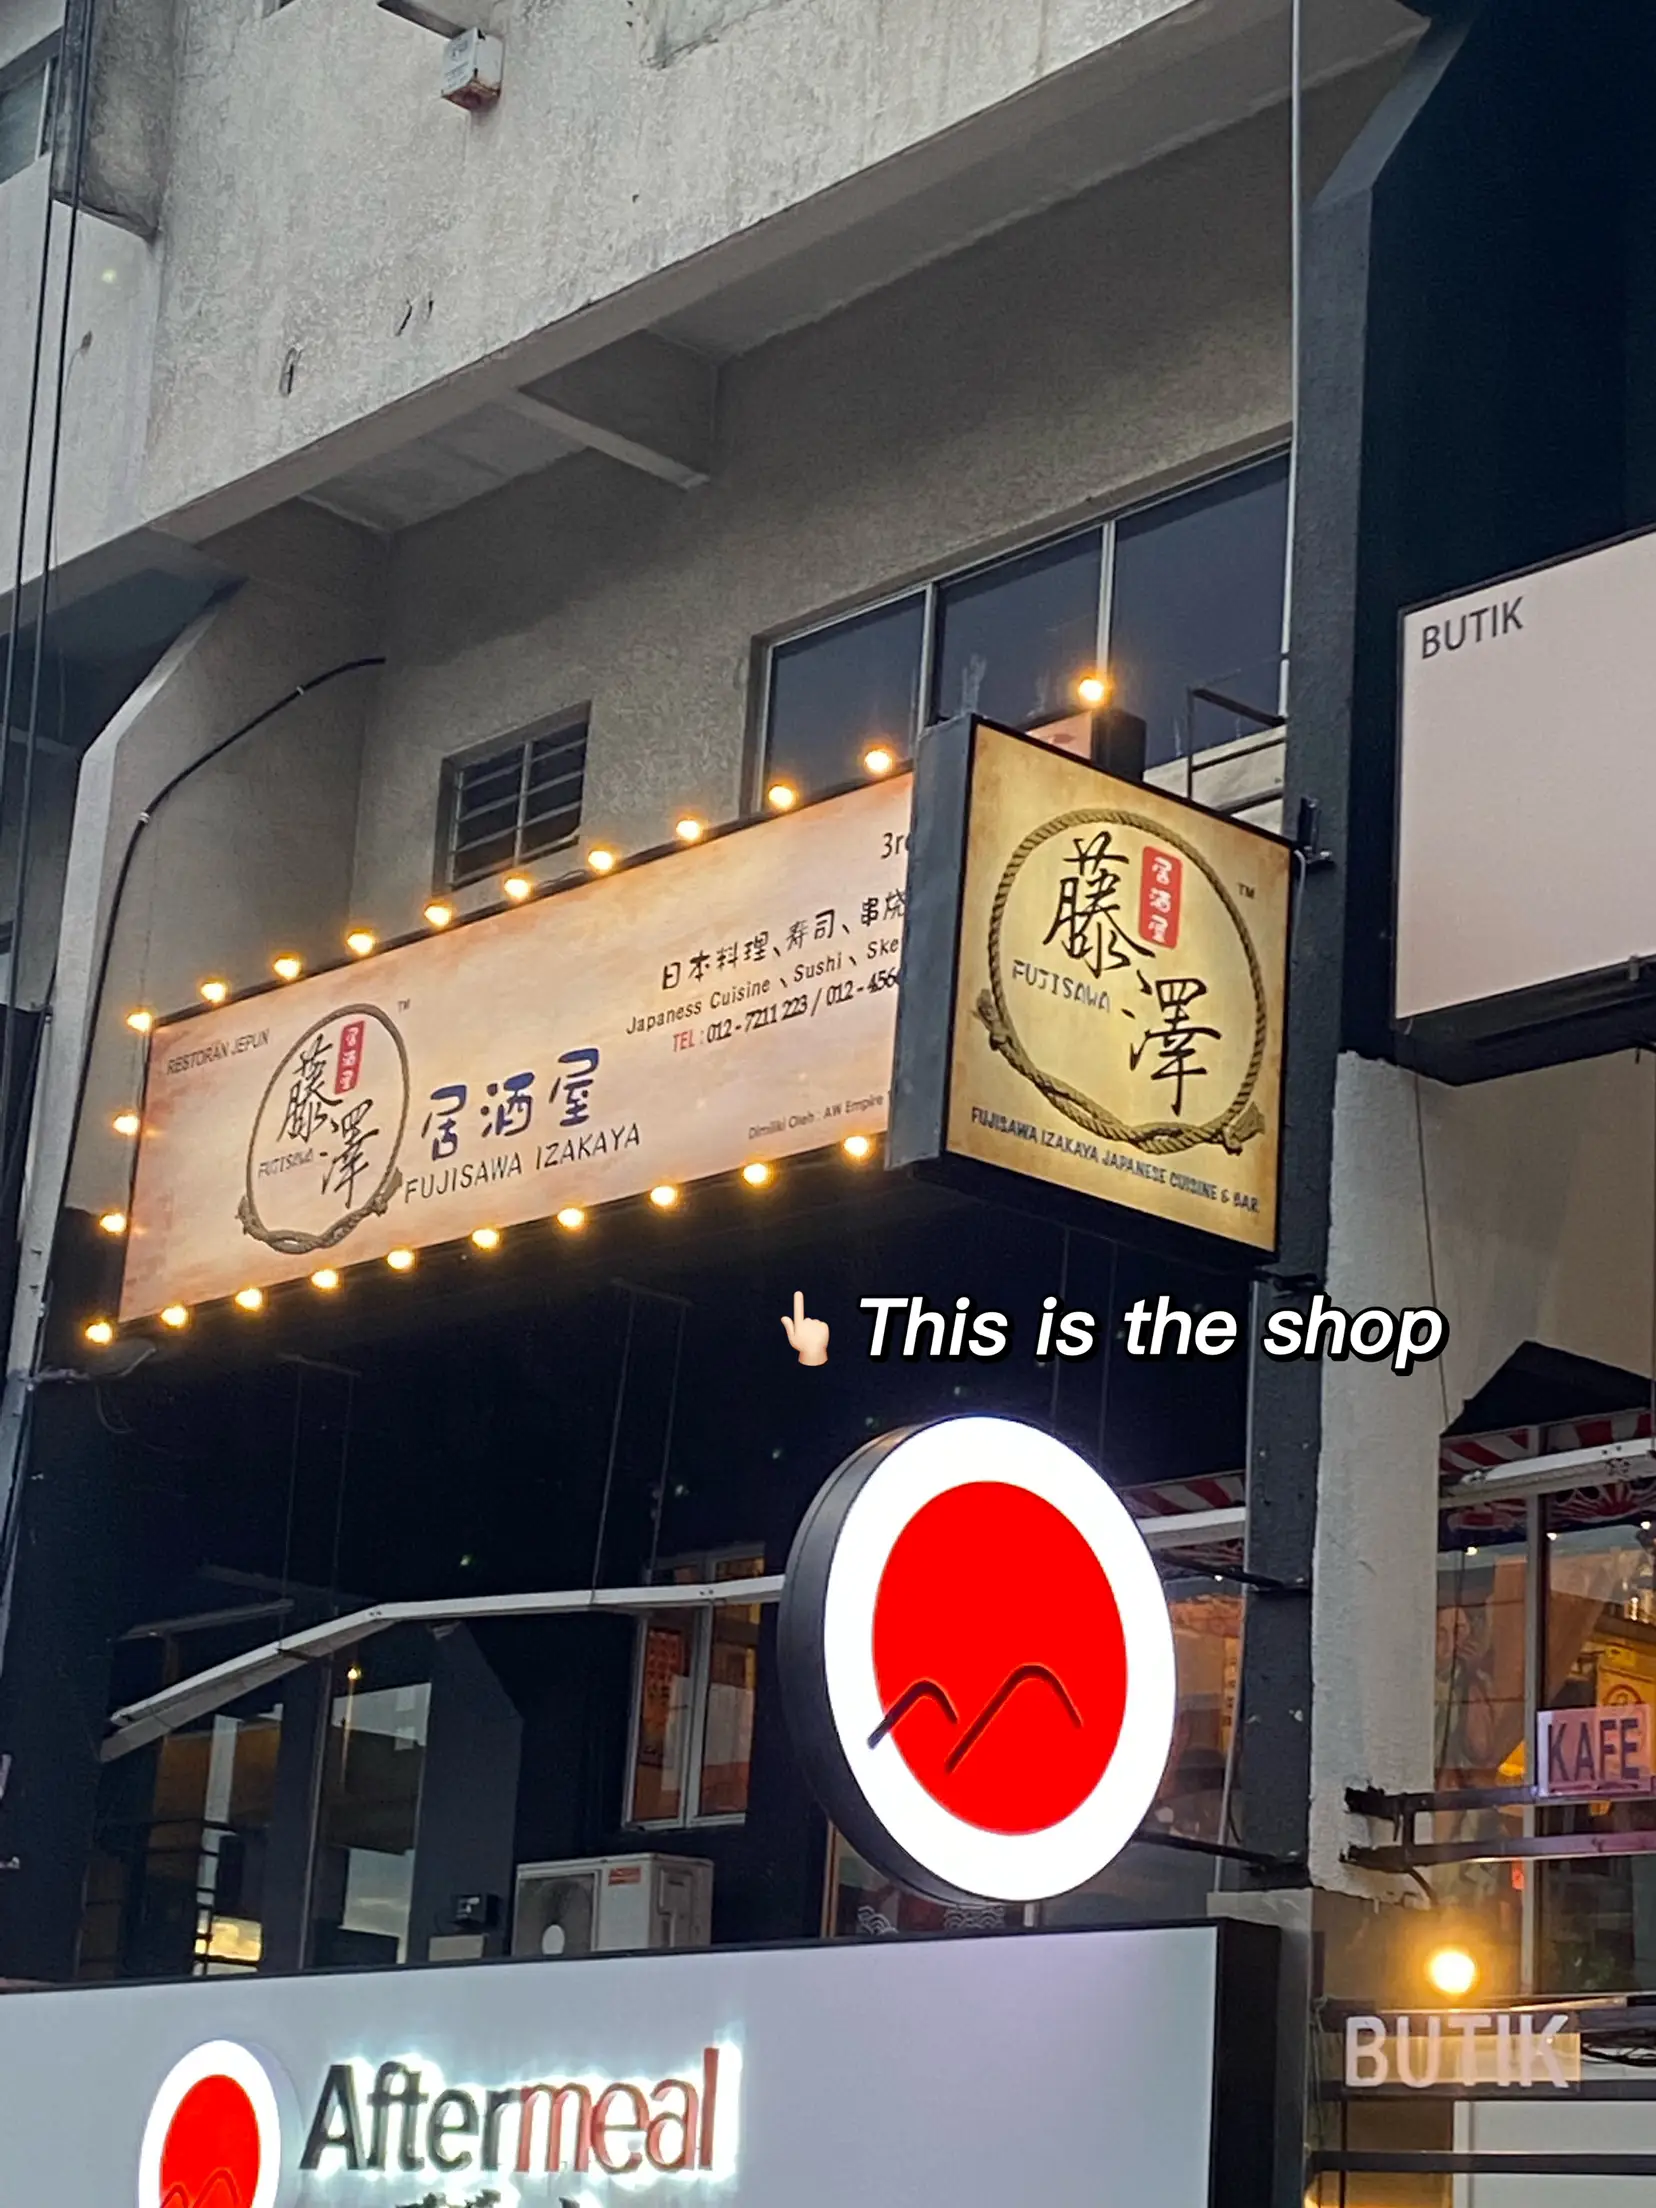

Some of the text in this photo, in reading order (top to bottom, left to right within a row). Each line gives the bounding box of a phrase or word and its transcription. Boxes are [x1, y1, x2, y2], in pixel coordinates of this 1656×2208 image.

[1422, 596, 1523, 659] BUTIK
[626, 1001, 702, 1034] Japaness
[1012, 959, 1110, 1013] FUJISAWA
[166, 1028, 270, 1075] RESTORAN JEPUN
[421, 1048, 599, 1161] 居酒屋
[405, 1123, 641, 1203] FUJISAWA IZAKAYA
[972, 1106, 1037, 1146] FUJISAWA
[1041, 1131, 1099, 1164] IZAKAYA
[1102, 1149, 1167, 1184] JAPANESE
[1169, 1171, 1218, 1201] CUISINE
[1547, 1718, 1640, 1783] KAFE
[1345, 2013, 1570, 2089] BUTIK
[300, 2047, 720, 2174] Aftermeal
